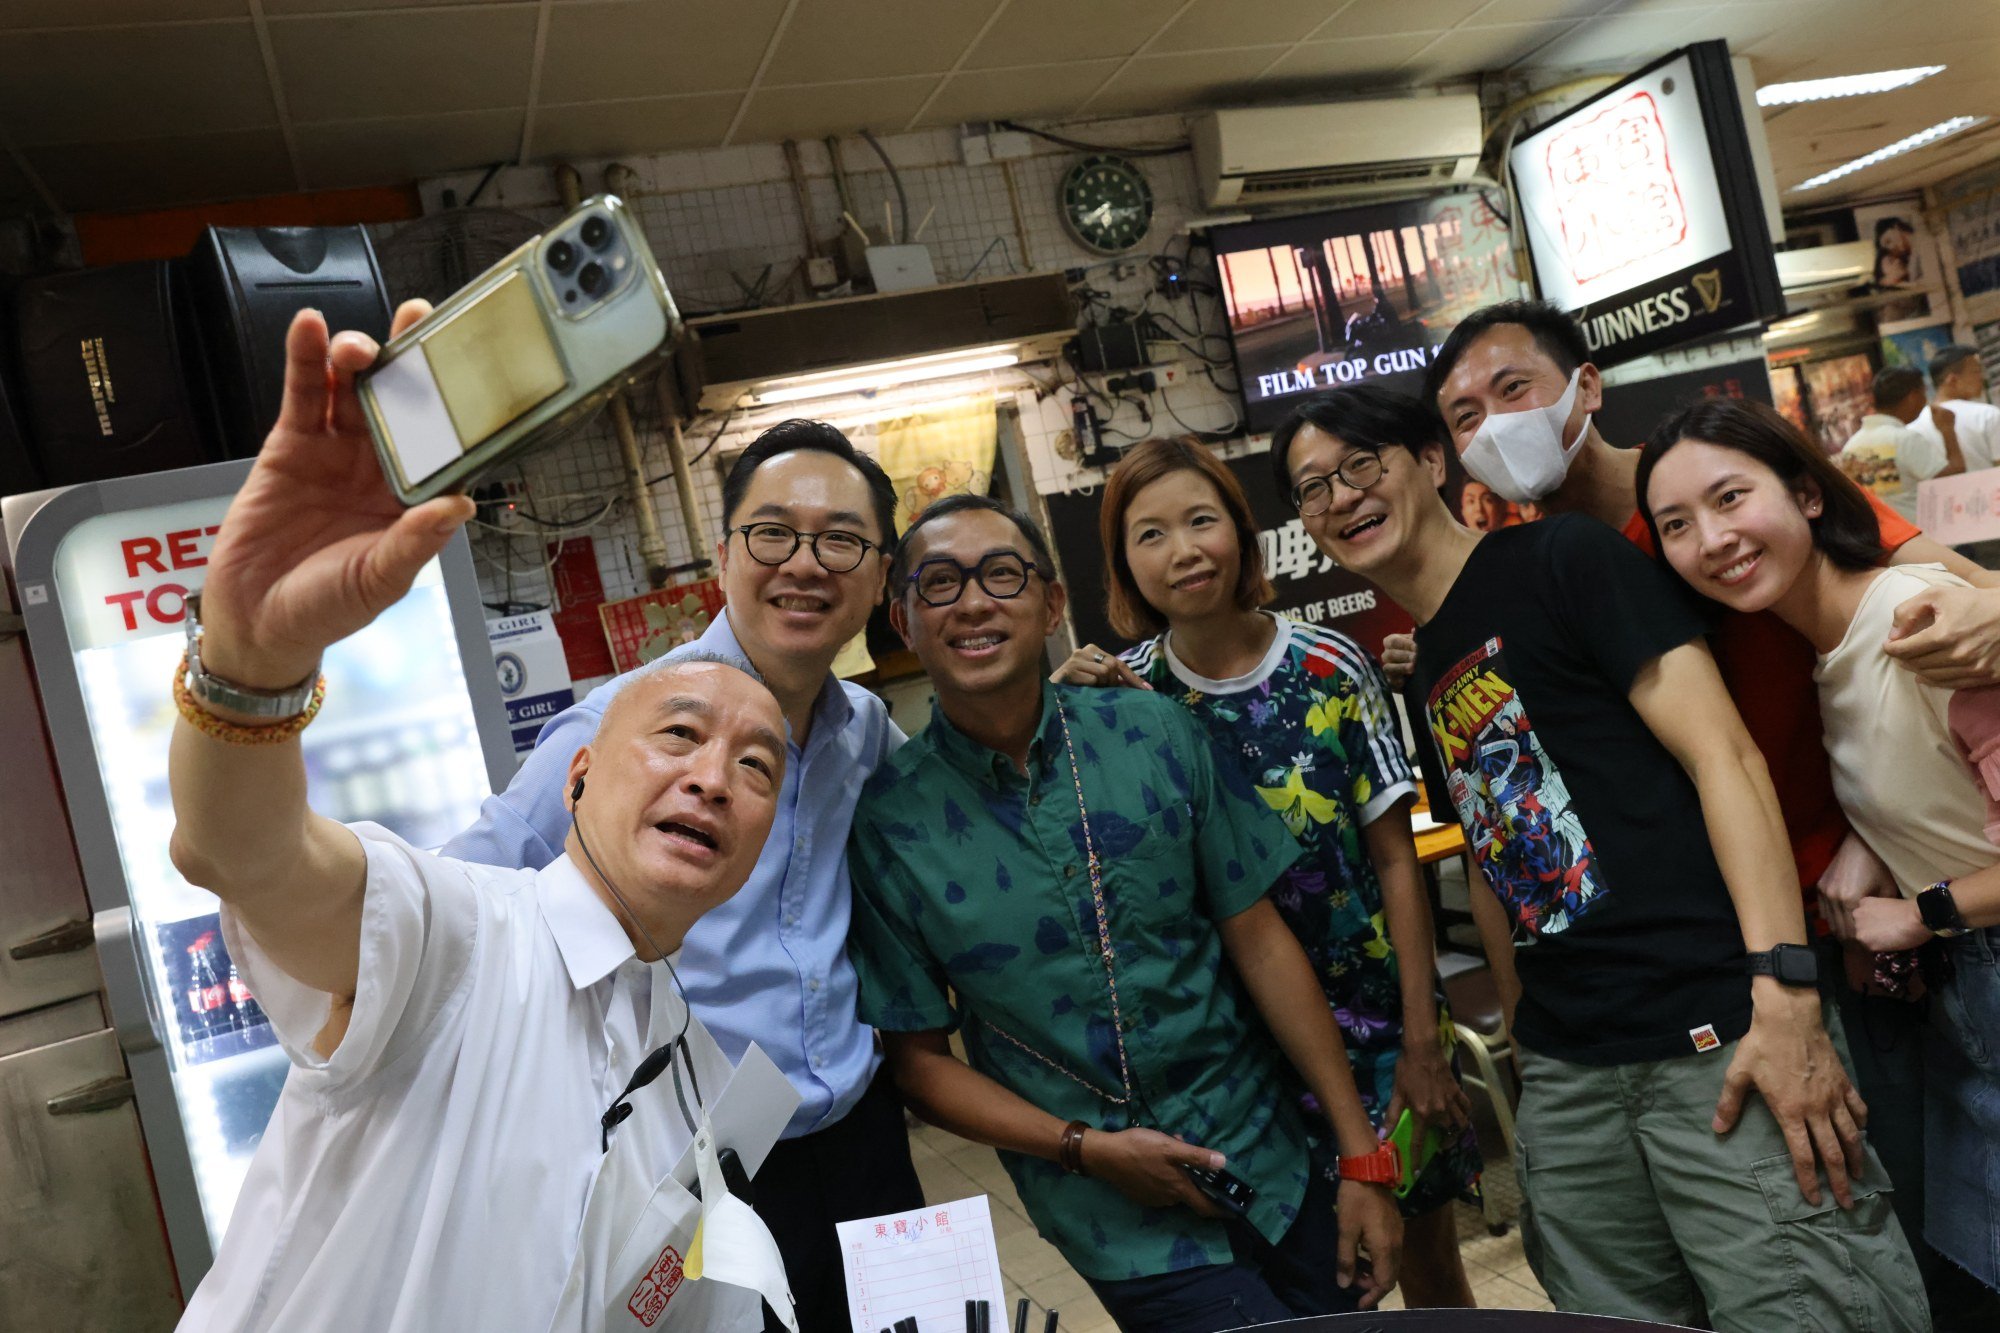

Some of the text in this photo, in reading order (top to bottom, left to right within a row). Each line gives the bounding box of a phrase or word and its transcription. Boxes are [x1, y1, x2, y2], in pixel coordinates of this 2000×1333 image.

[1576, 287, 1690, 351] UINNESS
[1258, 367, 1317, 397] FILM
[1320, 357, 1367, 385] TOP
[1374, 347, 1427, 375] GUN
[498, 616, 538, 631] GIRL
[1305, 601, 1325, 623] OF
[1327, 589, 1377, 618] BEERS
[1443, 665, 1479, 702] UNCANNY
[519, 701, 556, 718] GIRL
[1432, 670, 1514, 767] X-MEN
[874, 1210, 950, 1239] 東寶小館
